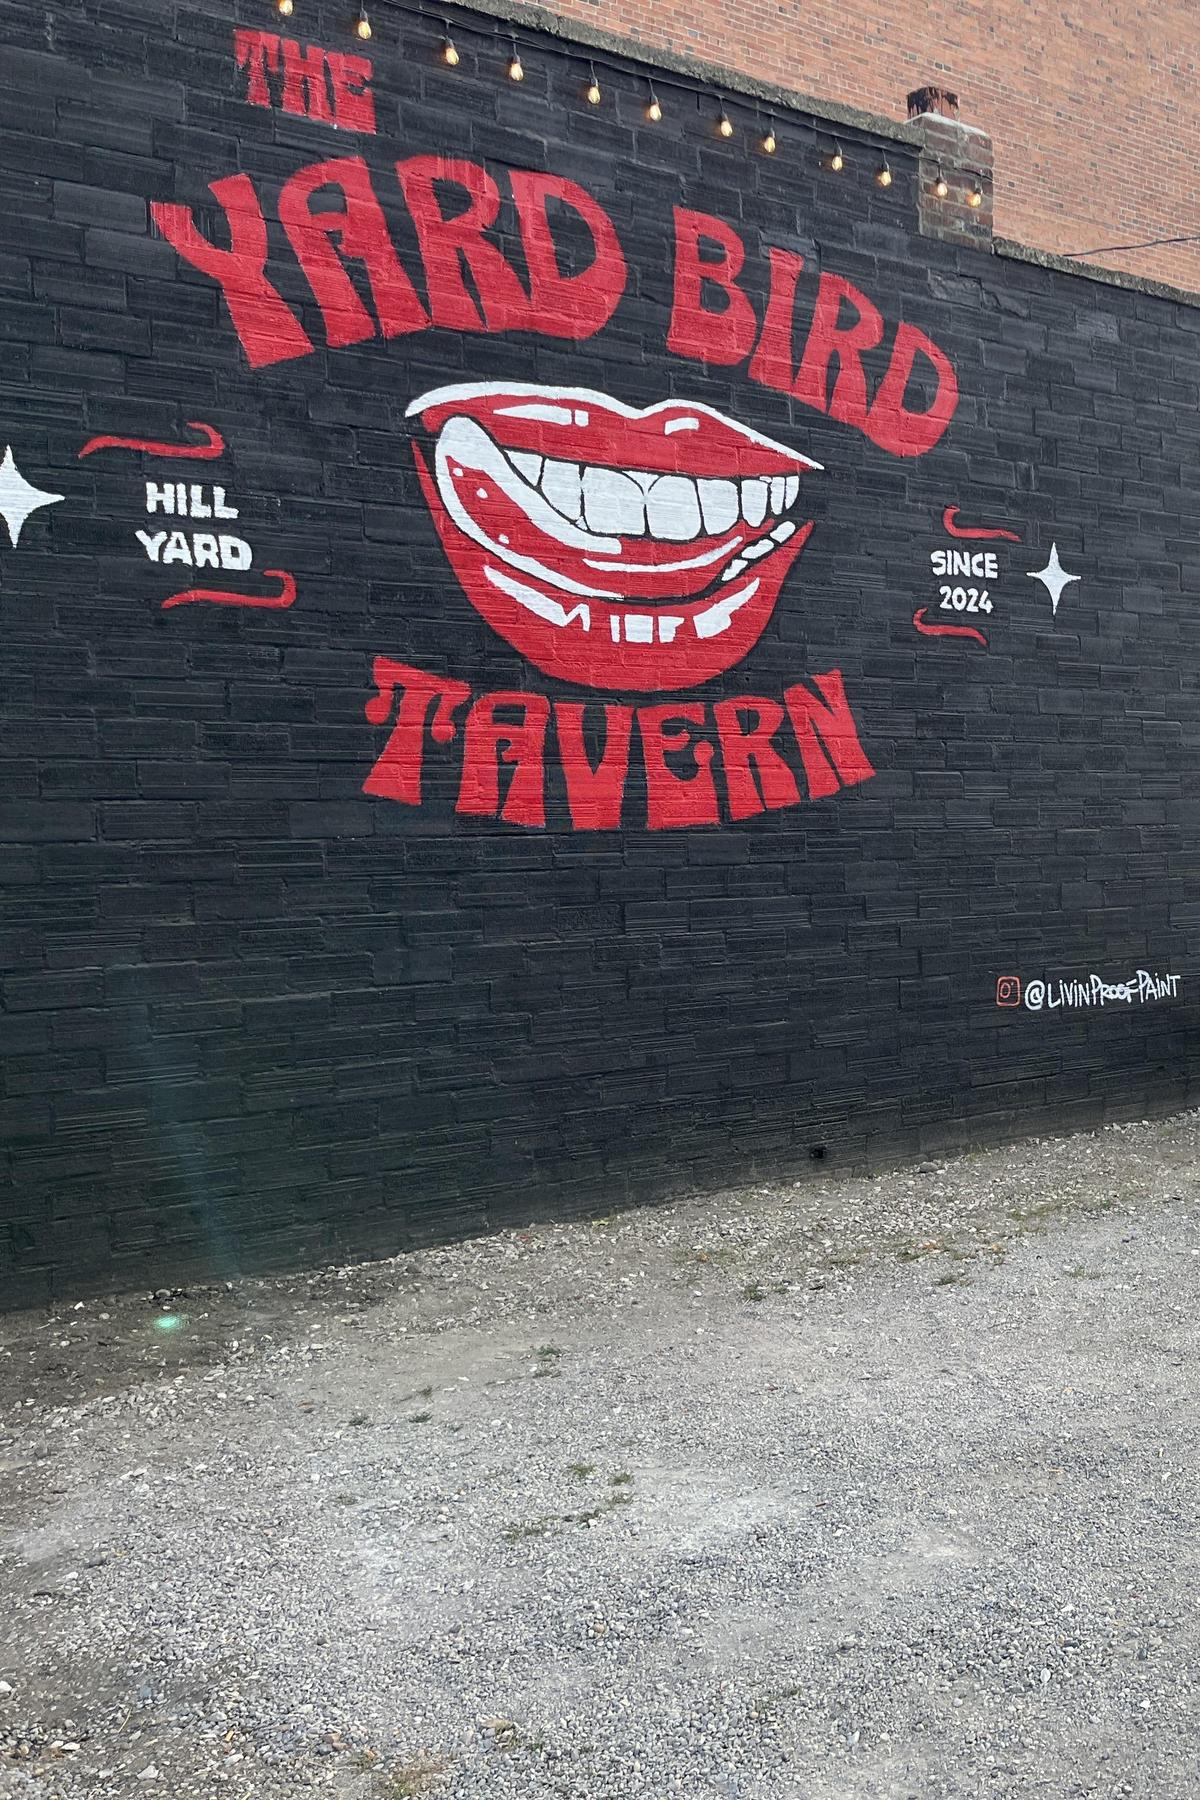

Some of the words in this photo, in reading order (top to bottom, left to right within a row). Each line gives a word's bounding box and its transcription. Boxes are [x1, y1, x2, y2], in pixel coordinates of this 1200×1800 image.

[235, 29, 377, 134] THE
[150, 155, 628, 368] YARD
[666, 205, 960, 458] BIRD
[145, 482, 239, 519] HILL
[135, 530, 252, 570] YARD
[931, 550, 999, 578] SINCE
[939, 586, 994, 613] 2024
[361, 656, 876, 831] TAVERN
